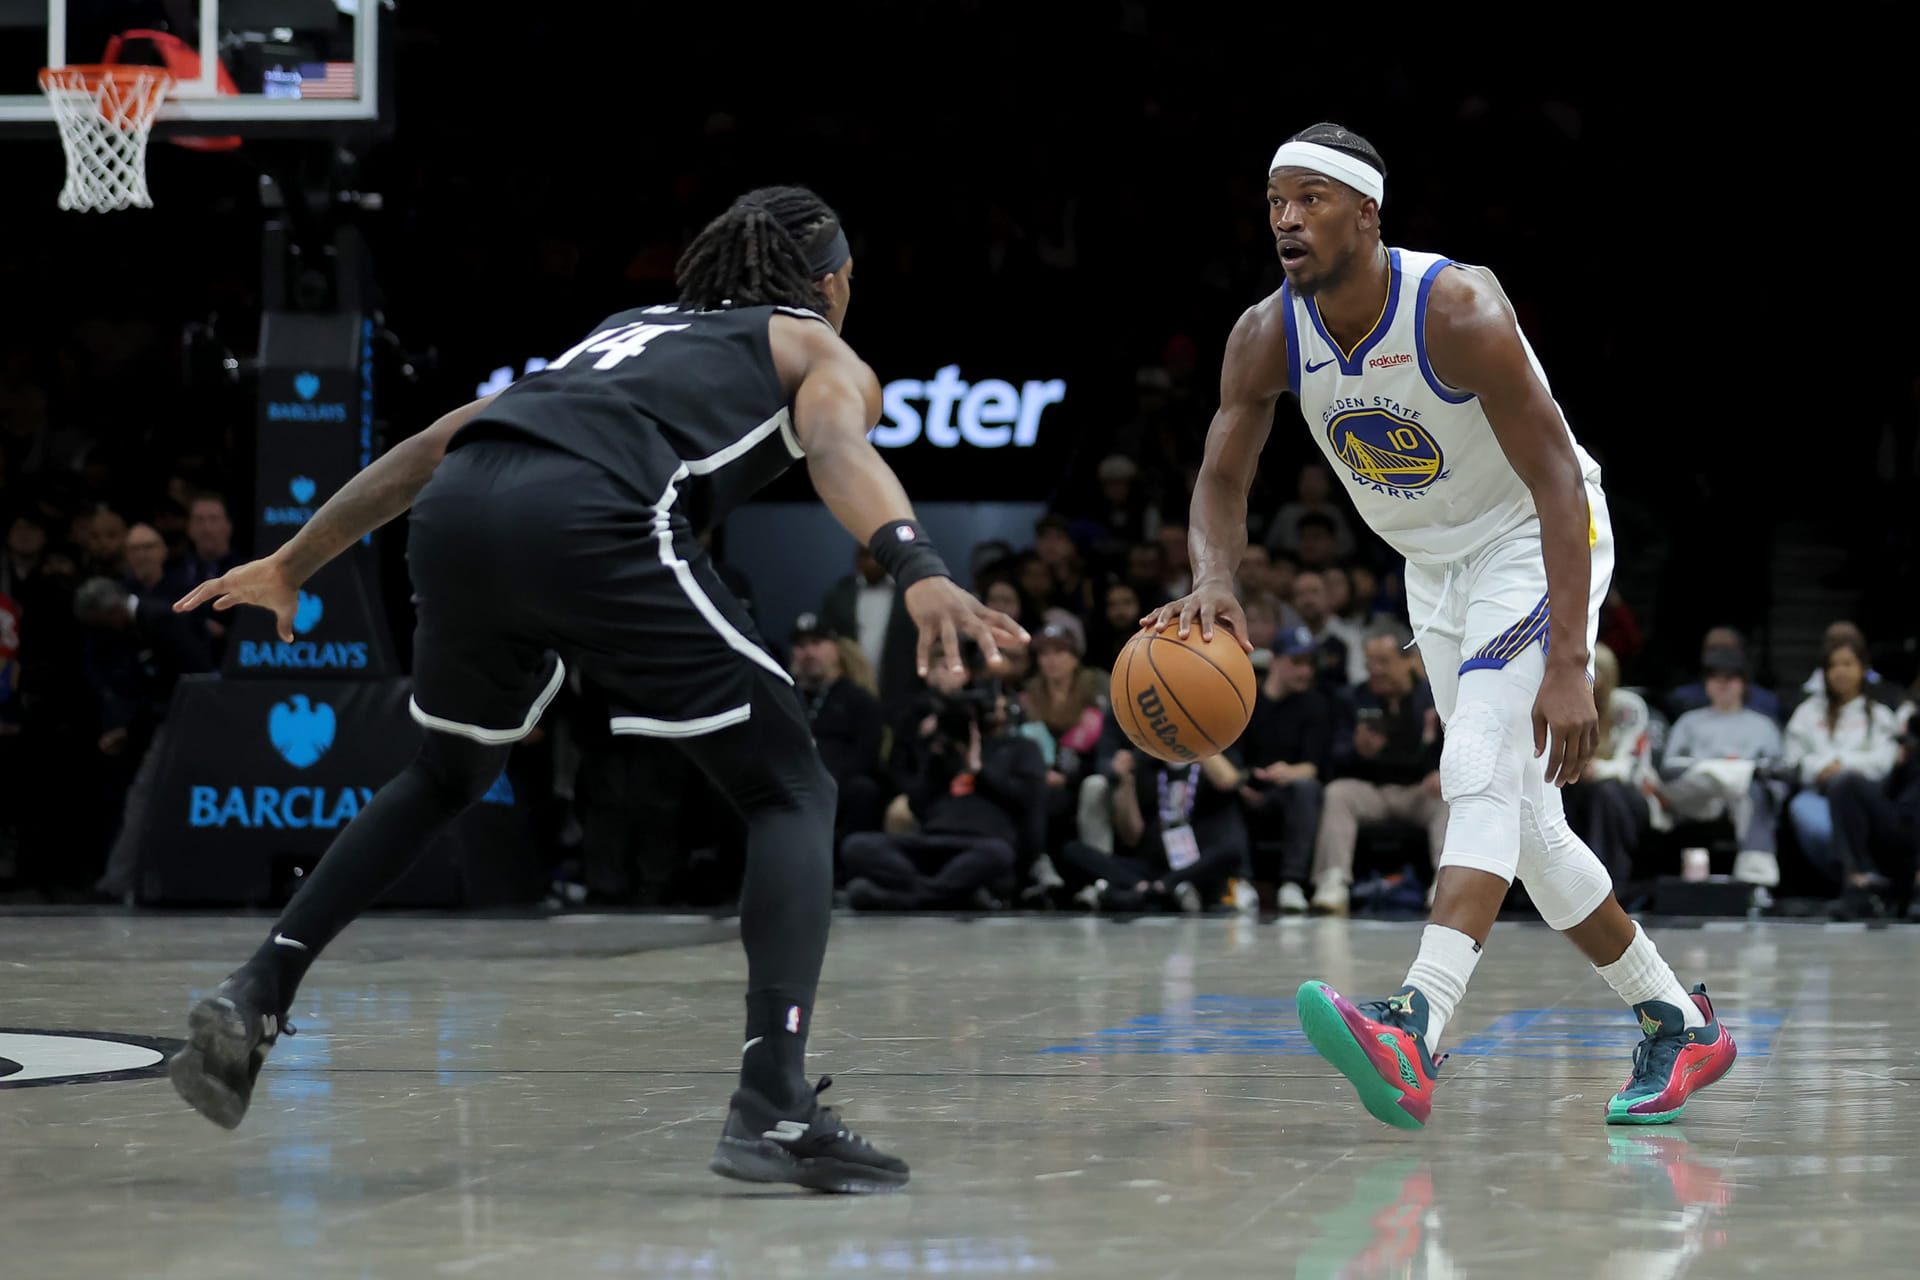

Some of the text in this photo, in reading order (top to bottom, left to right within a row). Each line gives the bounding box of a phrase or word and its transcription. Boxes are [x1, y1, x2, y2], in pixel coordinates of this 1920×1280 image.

[545, 321, 692, 370] 14
[1369, 353, 1413, 368] Rakuten
[866, 363, 1067, 448] ster
[1322, 396, 1422, 423] GOLDEN STATE
[1386, 428, 1419, 451] 10
[239, 640, 368, 669] BARCLAYS
[1136, 684, 1199, 760] Wilson
[189, 785, 375, 829] BARCLA
